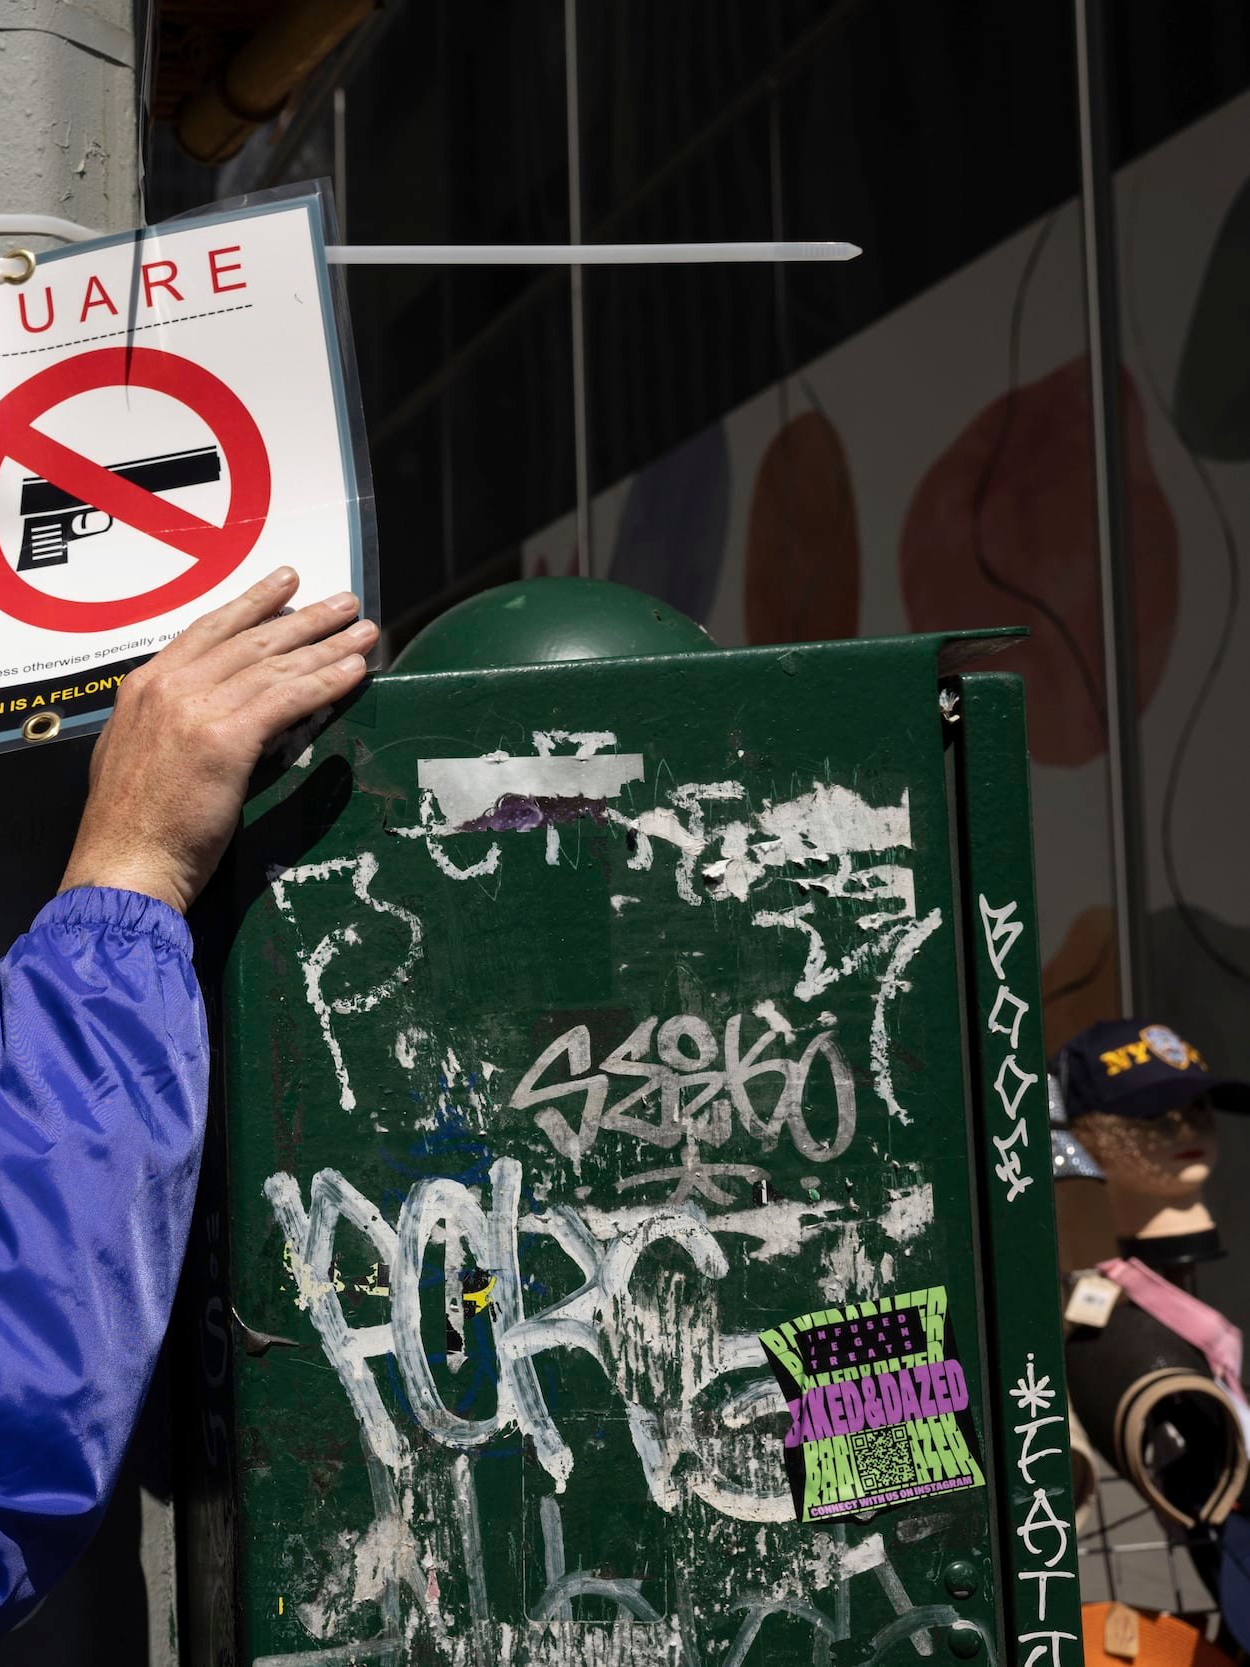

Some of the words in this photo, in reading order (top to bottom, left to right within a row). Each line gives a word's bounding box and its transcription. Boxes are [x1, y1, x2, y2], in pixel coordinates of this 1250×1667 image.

[23, 653, 91, 674] otherwise
[94, 636, 155, 660] specially
[158, 629, 186, 642] aut
[10, 696, 29, 712] IS
[31, 694, 46, 708] A
[50, 673, 124, 704] FELONY
[807, 1313, 908, 1343] INFUSED
[810, 1340, 913, 1370] TREATS
[785, 1359, 969, 1449] BAKED&DAZED
[810, 1501, 858, 1517] CONNECT
[859, 1494, 885, 1508] WITH
[885, 1491, 899, 1503] US
[900, 1488, 914, 1500] ON
[915, 1475, 973, 1496] INSTAGRAM
